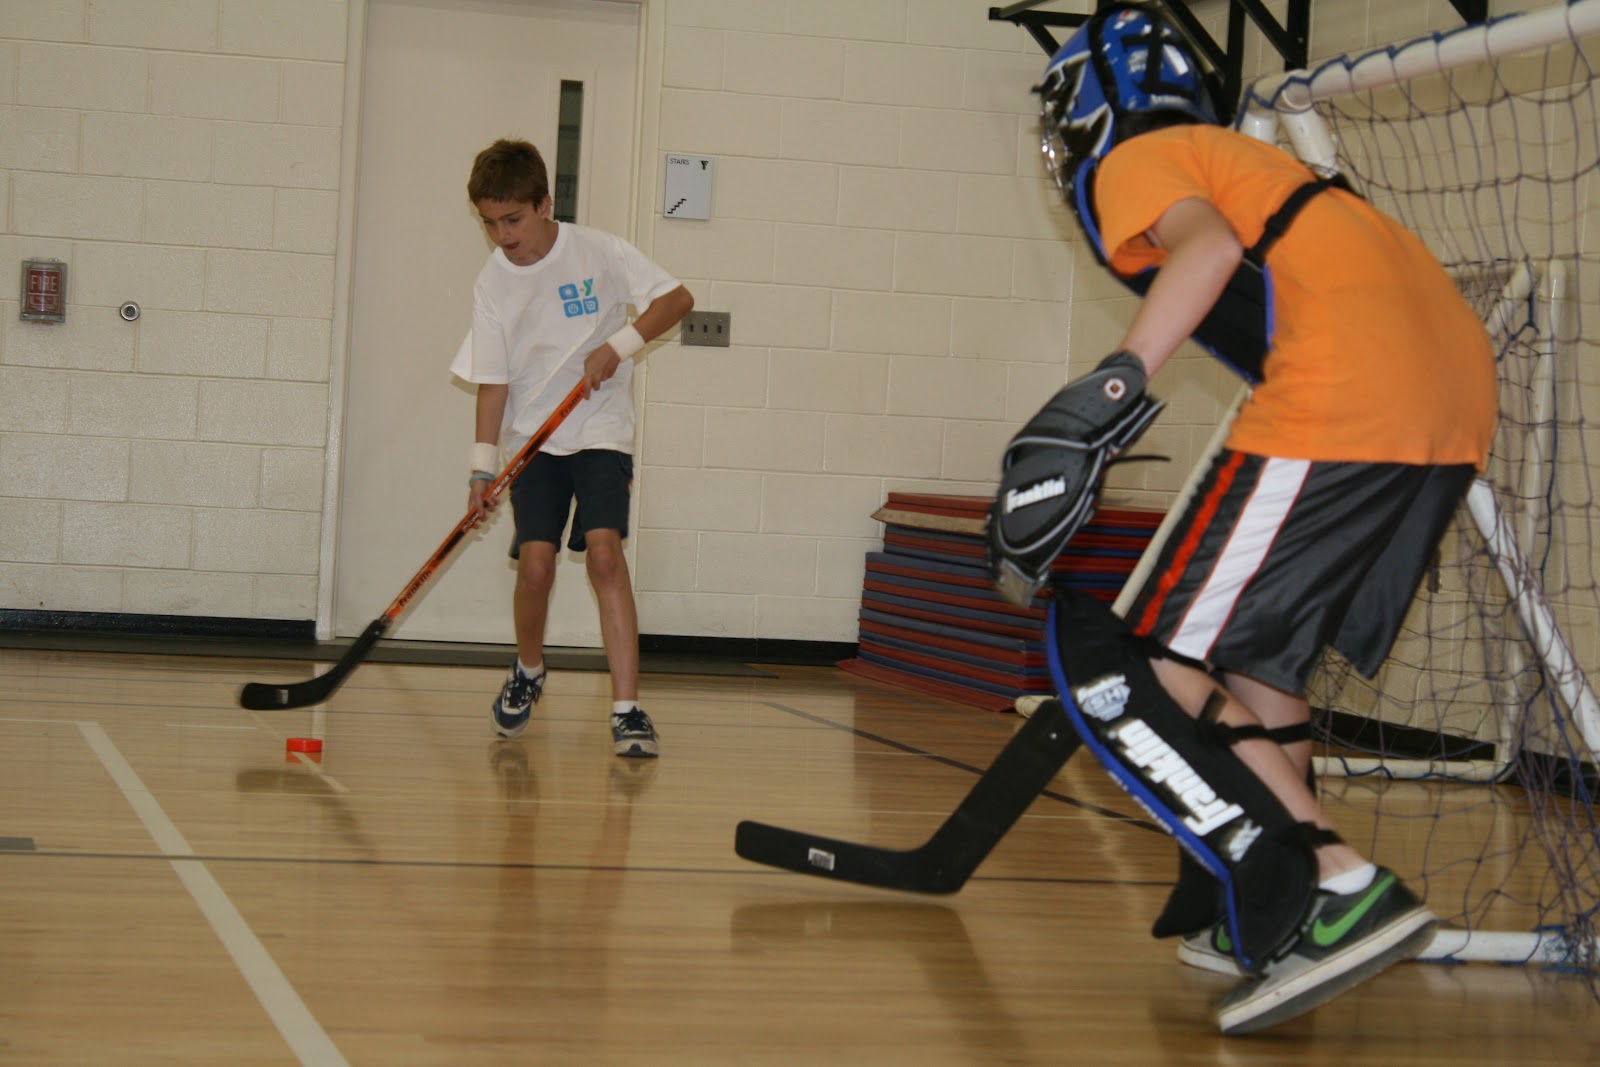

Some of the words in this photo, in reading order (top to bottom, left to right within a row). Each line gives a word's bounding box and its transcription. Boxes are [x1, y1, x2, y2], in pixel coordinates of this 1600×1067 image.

[669, 157, 690, 166] STAIRS
[31, 274, 58, 292] FIRE
[1006, 475, 1066, 514] Franklin
[399, 569, 433, 609] Franklin
[1117, 717, 1246, 838] Franklin
